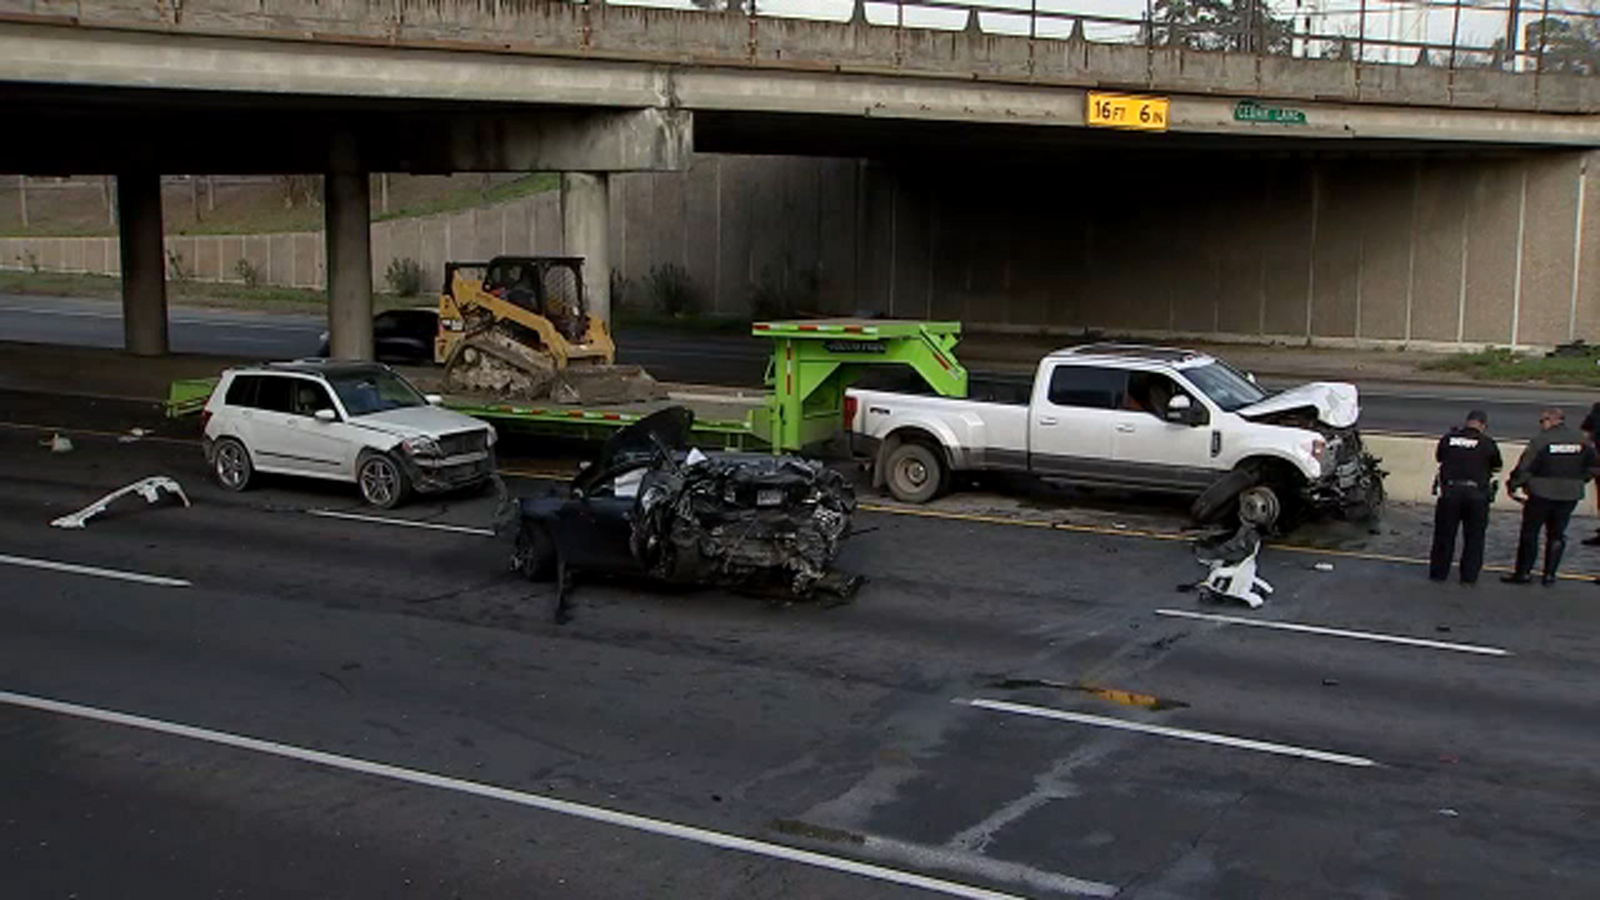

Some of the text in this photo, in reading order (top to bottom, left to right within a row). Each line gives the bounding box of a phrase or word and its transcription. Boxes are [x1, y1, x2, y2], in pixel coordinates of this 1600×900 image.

[1094, 100, 1164, 123] 16 FT 6 IN
